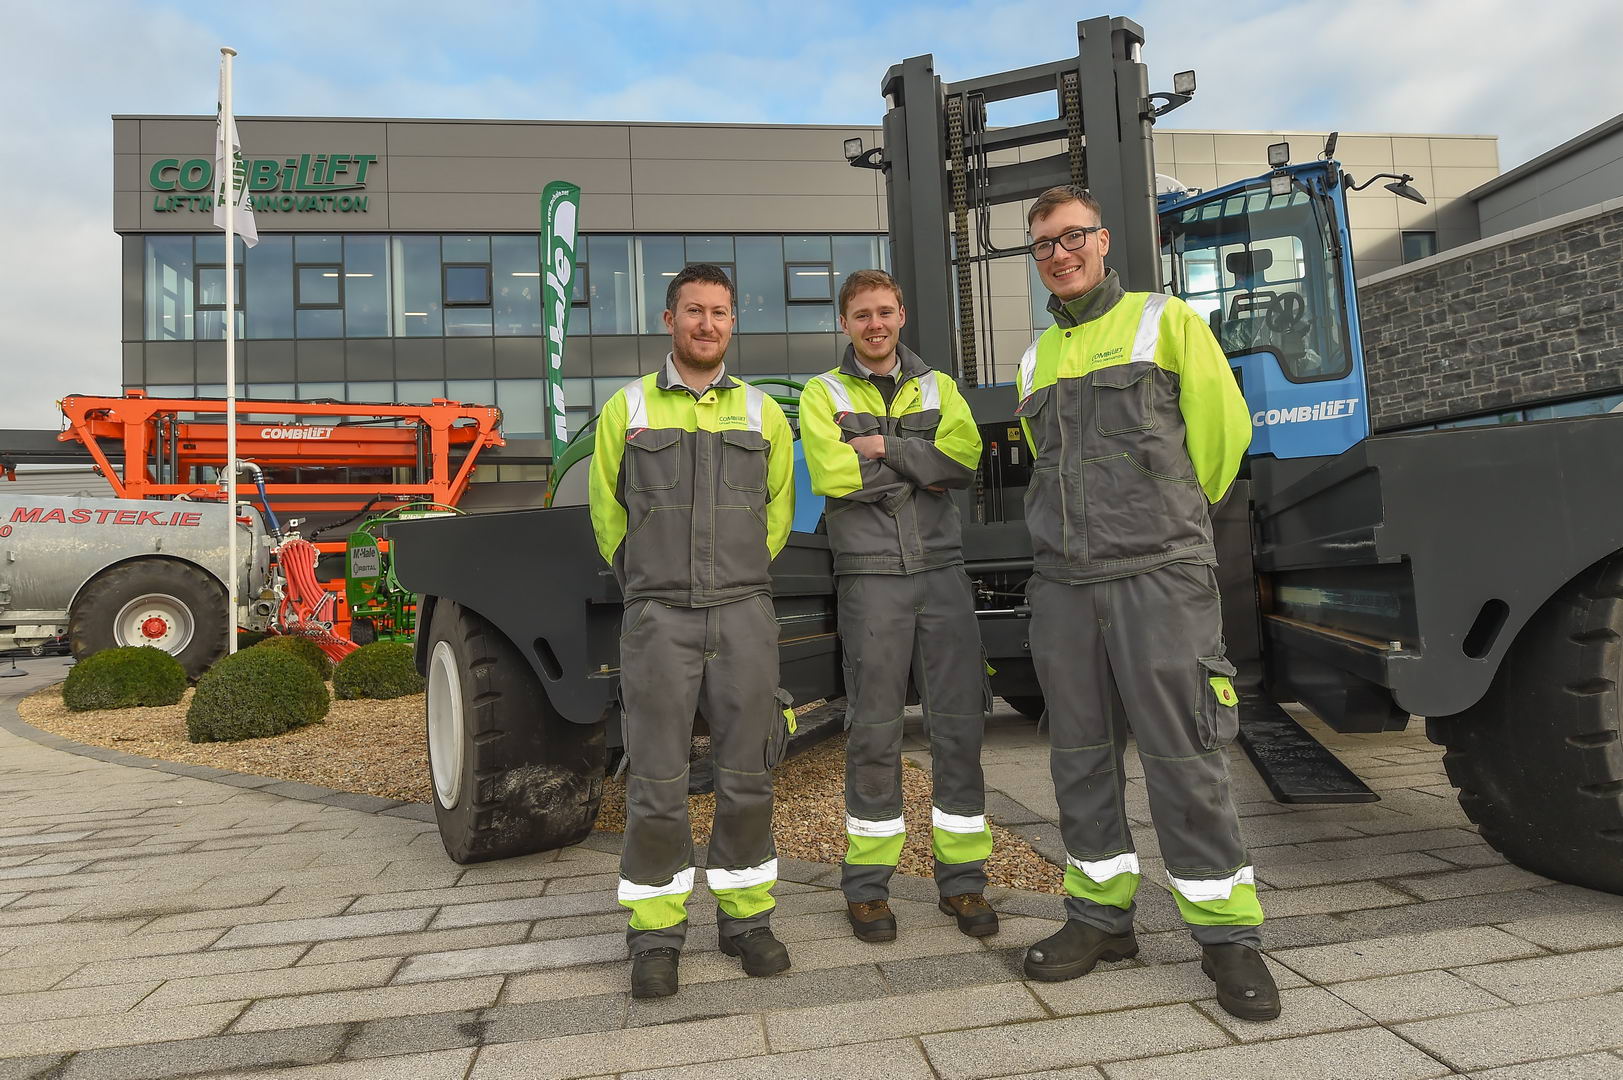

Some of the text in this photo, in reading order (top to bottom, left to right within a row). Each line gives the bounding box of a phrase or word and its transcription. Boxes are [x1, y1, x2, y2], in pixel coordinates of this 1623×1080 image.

[149, 153, 377, 192] COBiLiFT
[153, 195, 215, 212] LIFTIN
[10, 506, 202, 527] MASTEK.IE
